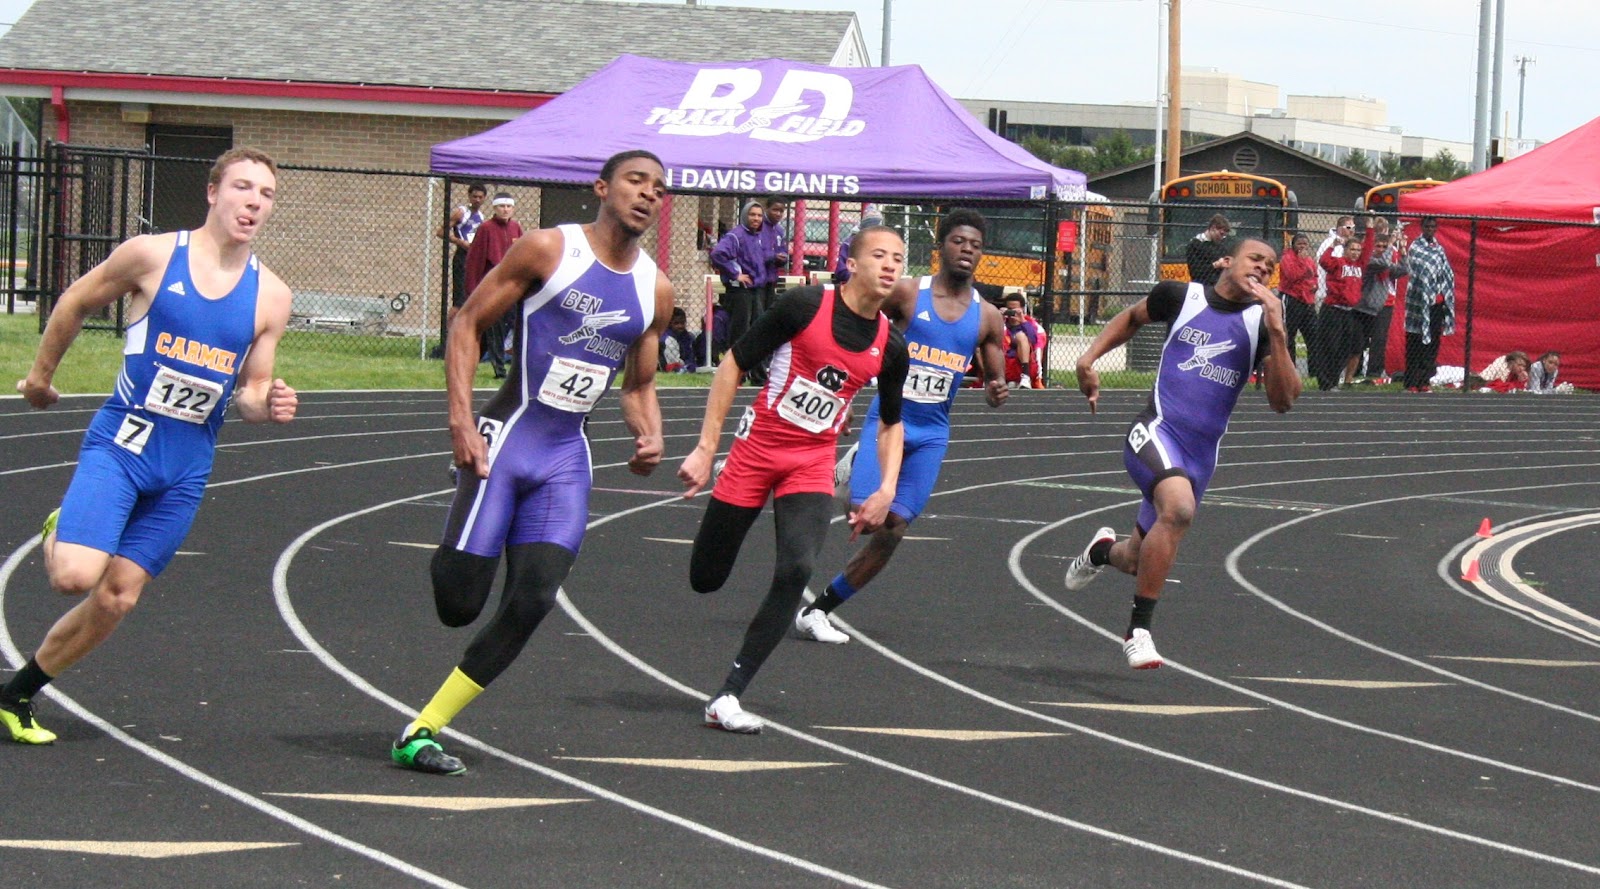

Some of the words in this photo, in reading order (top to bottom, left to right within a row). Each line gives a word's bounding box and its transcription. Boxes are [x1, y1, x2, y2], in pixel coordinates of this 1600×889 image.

[643, 106, 746, 127] TRACK
[783, 115, 866, 137] FIELD
[681, 168, 756, 190] DAVIS
[764, 171, 860, 194] GIANTS
[1195, 181, 1231, 195] SCHOOL
[1234, 181, 1252, 194] BUS
[560, 288, 603, 315] BEN
[584, 334, 627, 361] DAVIS
[1178, 326, 1211, 346] BEN
[155, 332, 237, 375] CARMEL
[907, 341, 966, 373] CARMEL
[560, 373, 593, 399] 42
[910, 373, 946, 392] 114
[1200, 363, 1240, 388] DAVIS
[162, 383, 211, 413] 122
[791, 391, 834, 420] 400
[122, 417, 148, 445] 7
[480, 421, 495, 448] 6
[1131, 428, 1146, 449] 3
